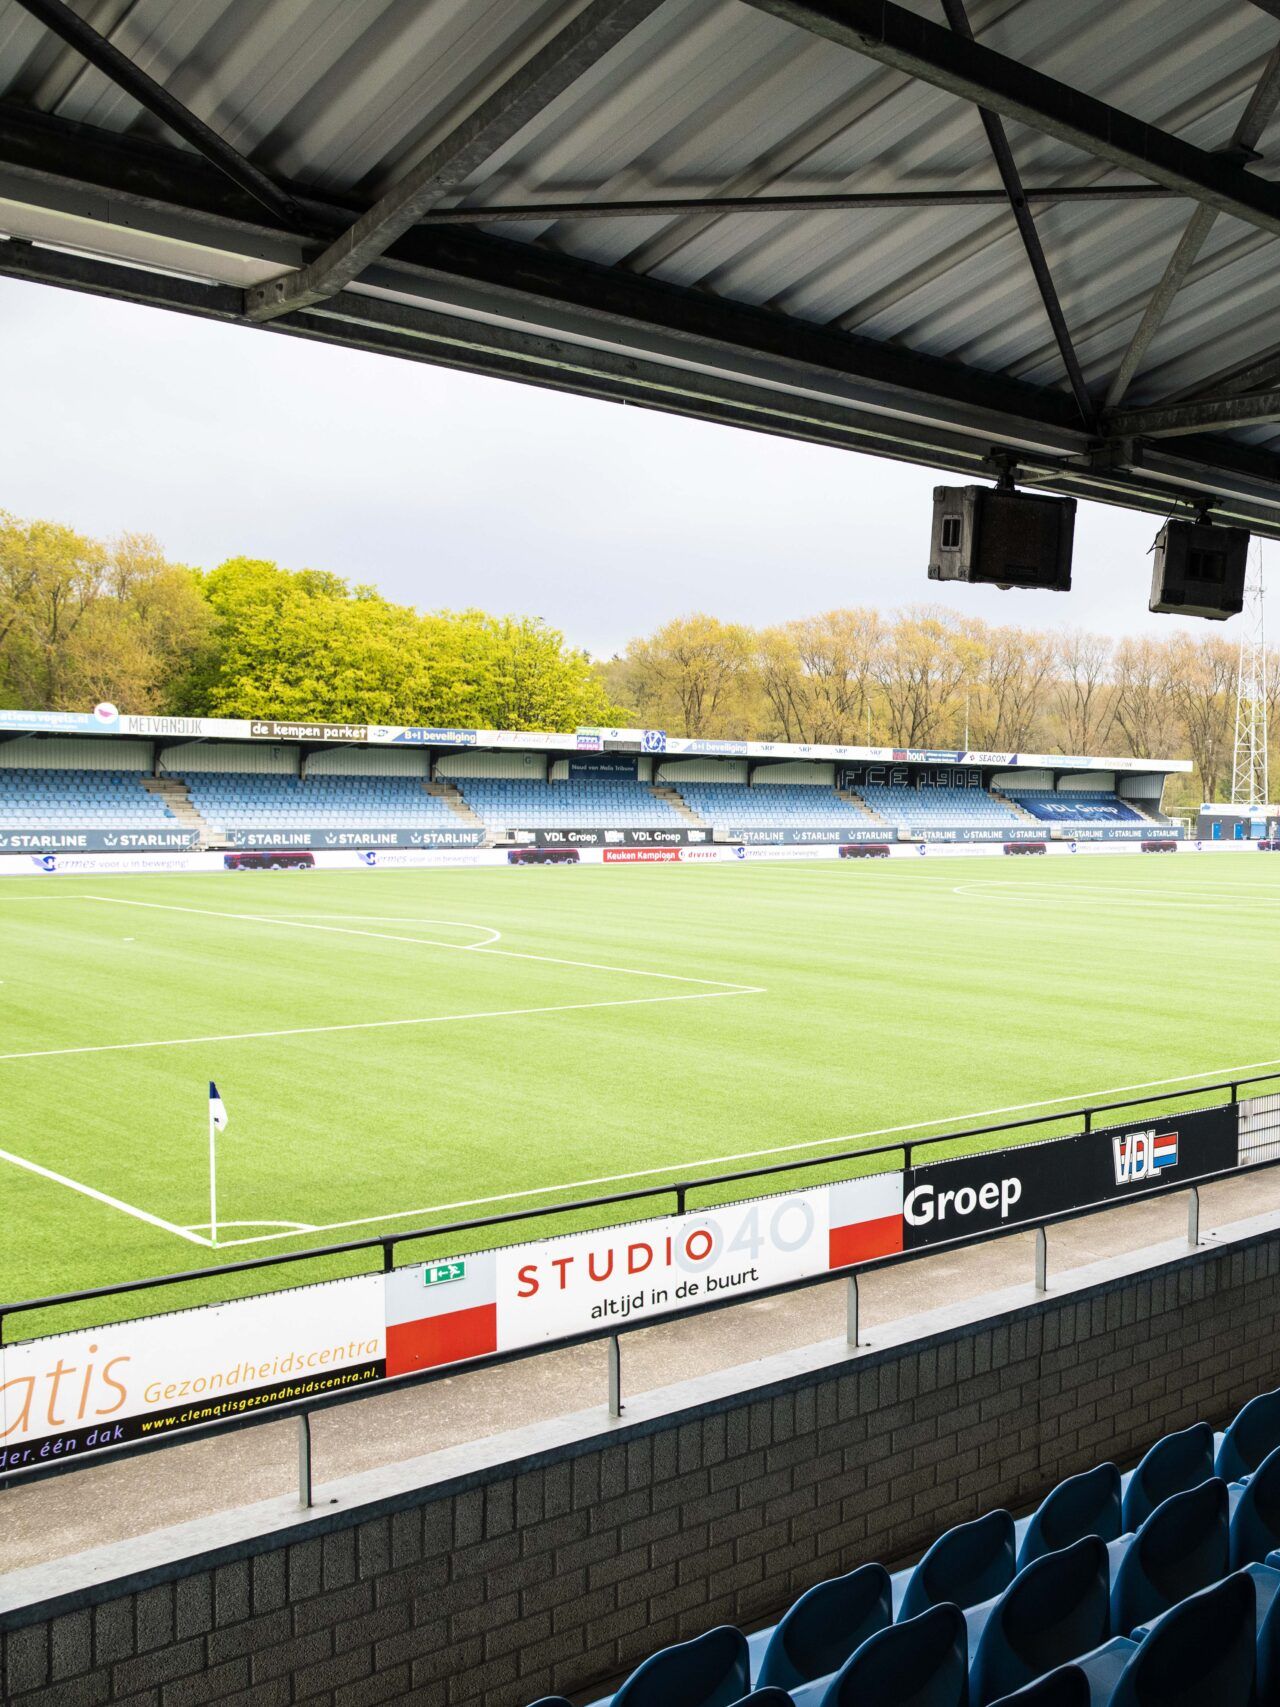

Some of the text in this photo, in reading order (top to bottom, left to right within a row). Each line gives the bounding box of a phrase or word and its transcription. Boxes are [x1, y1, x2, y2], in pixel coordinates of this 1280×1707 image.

[252, 723, 269, 734] de
[273, 723, 314, 738] kempen
[323, 726, 366, 739] parket
[979, 754, 1006, 763] SEACON
[1039, 803, 1119, 815] VDL Groep
[249, 834, 311, 845] STARLINE
[339, 833, 398, 844] STARLINE
[423, 833, 479, 843] STARLINE
[543, 832, 566, 841] VDL
[568, 832, 597, 843] Groep
[632, 832, 651, 841] VDL
[653, 832, 681, 843] Groep
[743, 832, 784, 841] STARLINE
[802, 832, 840, 841] STARLINE
[857, 832, 893, 840] STARLINE
[922, 831, 956, 839] STARLINE
[970, 831, 1003, 839] STARLINE
[1016, 831, 1047, 839] STARLINE
[1115, 830, 1142, 838] STARLINE
[11, 835, 87, 847] STARLINE
[120, 834, 191, 846] STARLINE
[607, 851, 635, 860] Keuken
[637, 850, 675, 860] Kampioen
[1112, 1129, 1161, 1186] VDL
[903, 1177, 1022, 1226] Groep
[517, 1230, 713, 1298] STUDIO
[590, 1267, 759, 1319] altijd in de buurt
[144, 1338, 379, 1404] Gezondheidscentra
[142, 1367, 376, 1432] www.clematisgezondheidscentra.nl
[40, 1437, 77, 1458] één
[86, 1425, 124, 1447] dak
